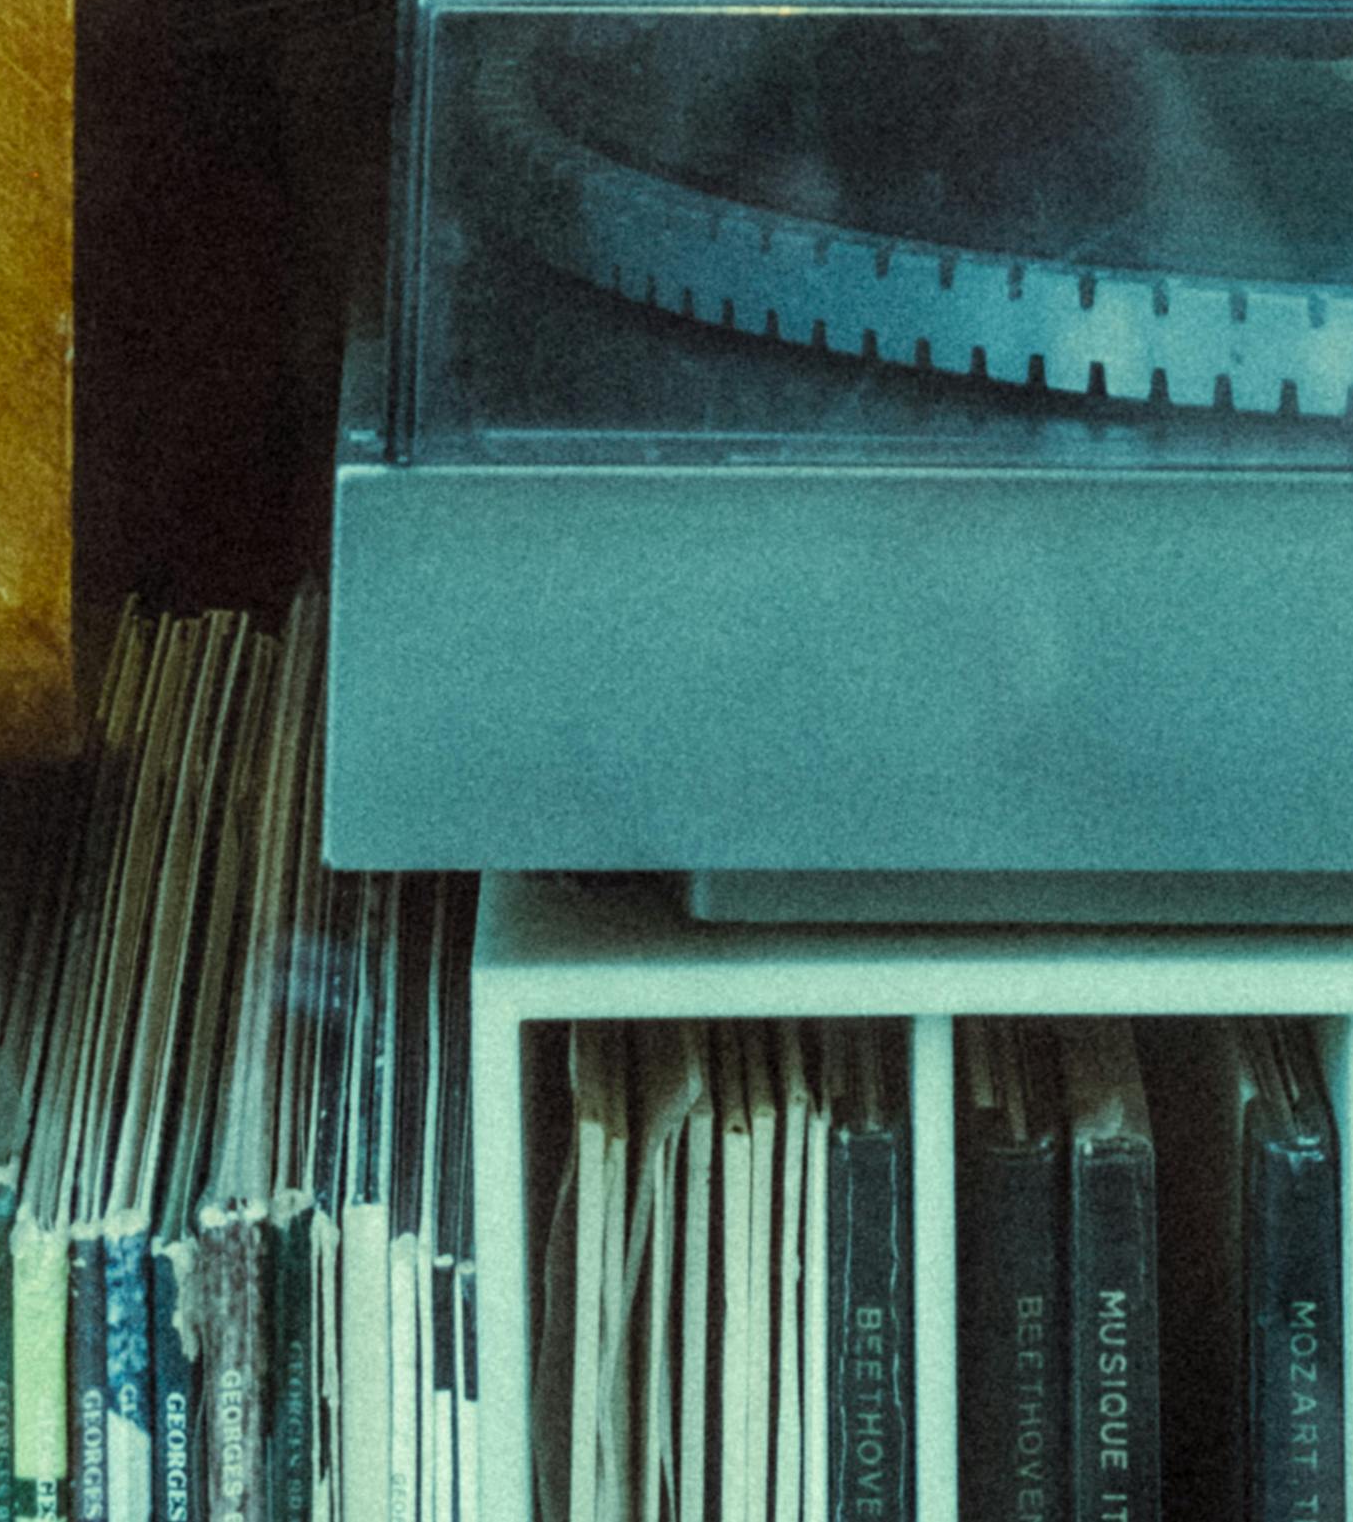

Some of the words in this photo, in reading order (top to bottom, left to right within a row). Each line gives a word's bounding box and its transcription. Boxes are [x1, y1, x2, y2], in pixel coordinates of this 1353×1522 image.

[221, 1369, 245, 1498] GEORGES
[1097, 1289, 1129, 1471] MUSIQUE
[82, 1388, 105, 1520] GEORGES
[165, 1391, 188, 1522] GEORGES
